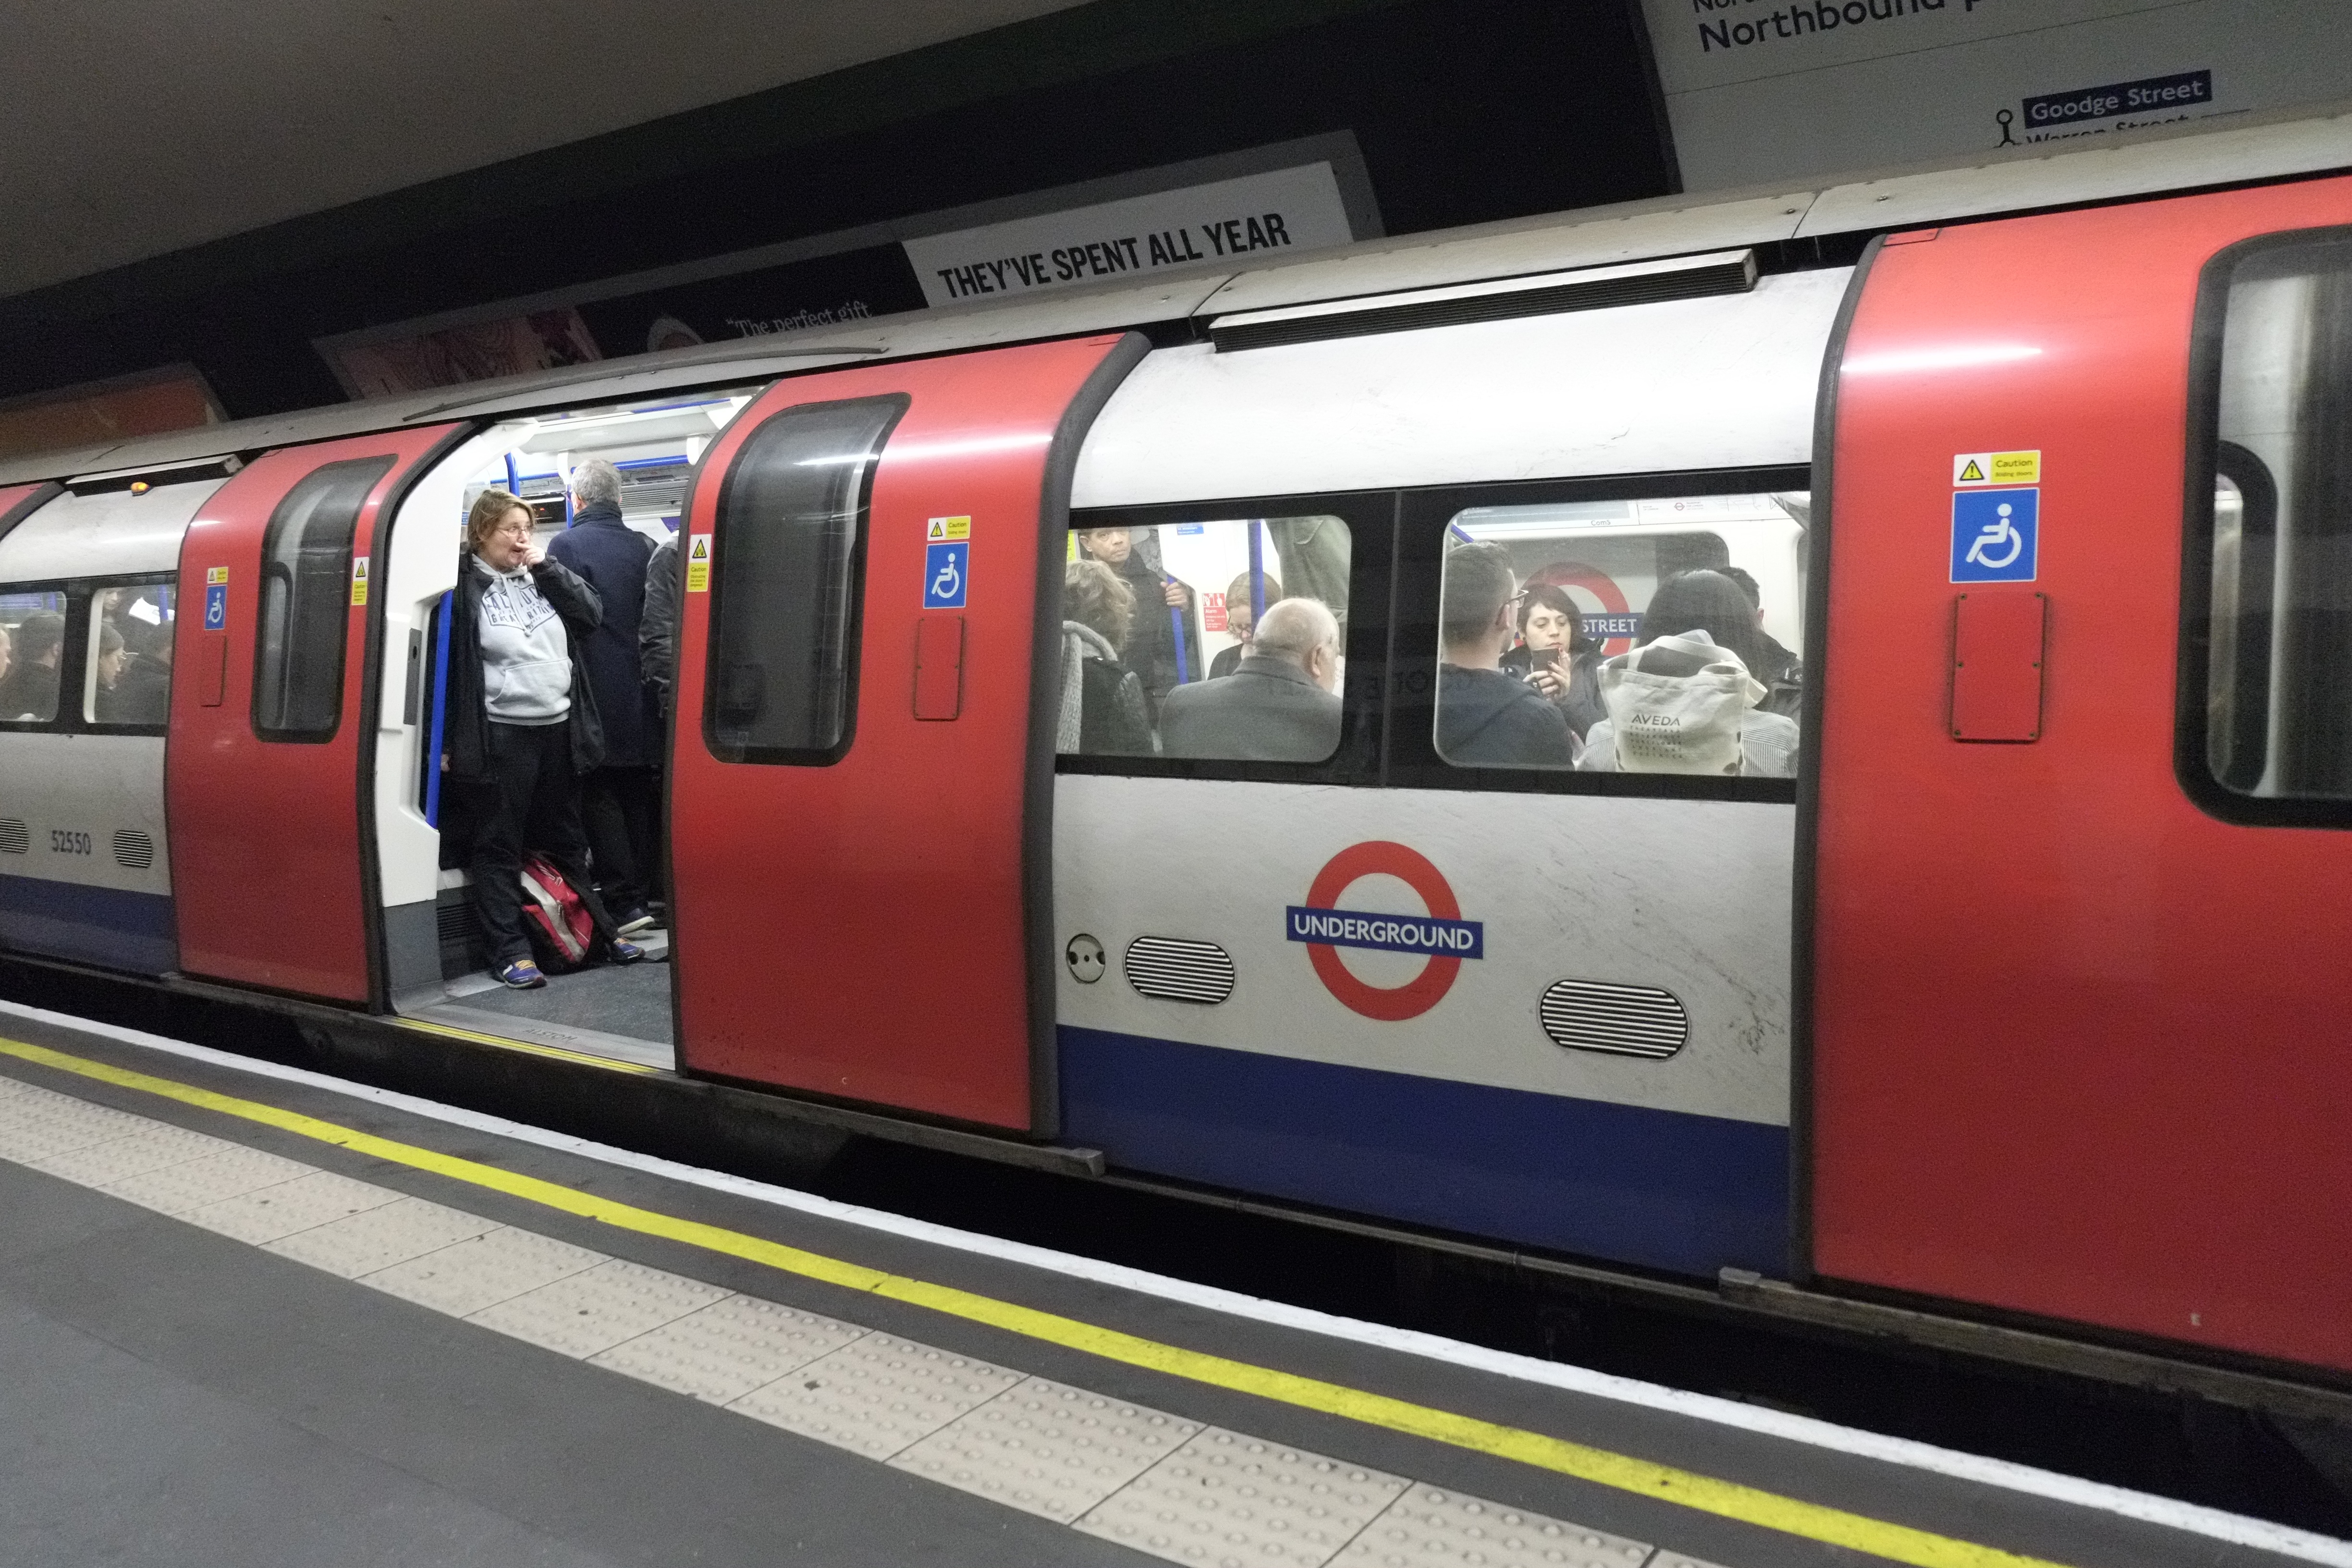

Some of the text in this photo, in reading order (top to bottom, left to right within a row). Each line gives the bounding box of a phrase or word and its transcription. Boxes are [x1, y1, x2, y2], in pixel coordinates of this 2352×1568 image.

[1699, 0, 1945, 52] Northboun
[2031, 80, 2204, 120] Goodge Street
[937, 213, 1291, 298] THEY'VE SPENT ALL YEAR
[773, 309, 837, 333] perfect
[1996, 460, 2033, 468] Caution
[1582, 619, 1637, 633] STREET
[1632, 714, 1680, 726] AVEDA
[51, 830, 91, 855] 52550
[1294, 914, 1473, 950] UNDERGROUND
